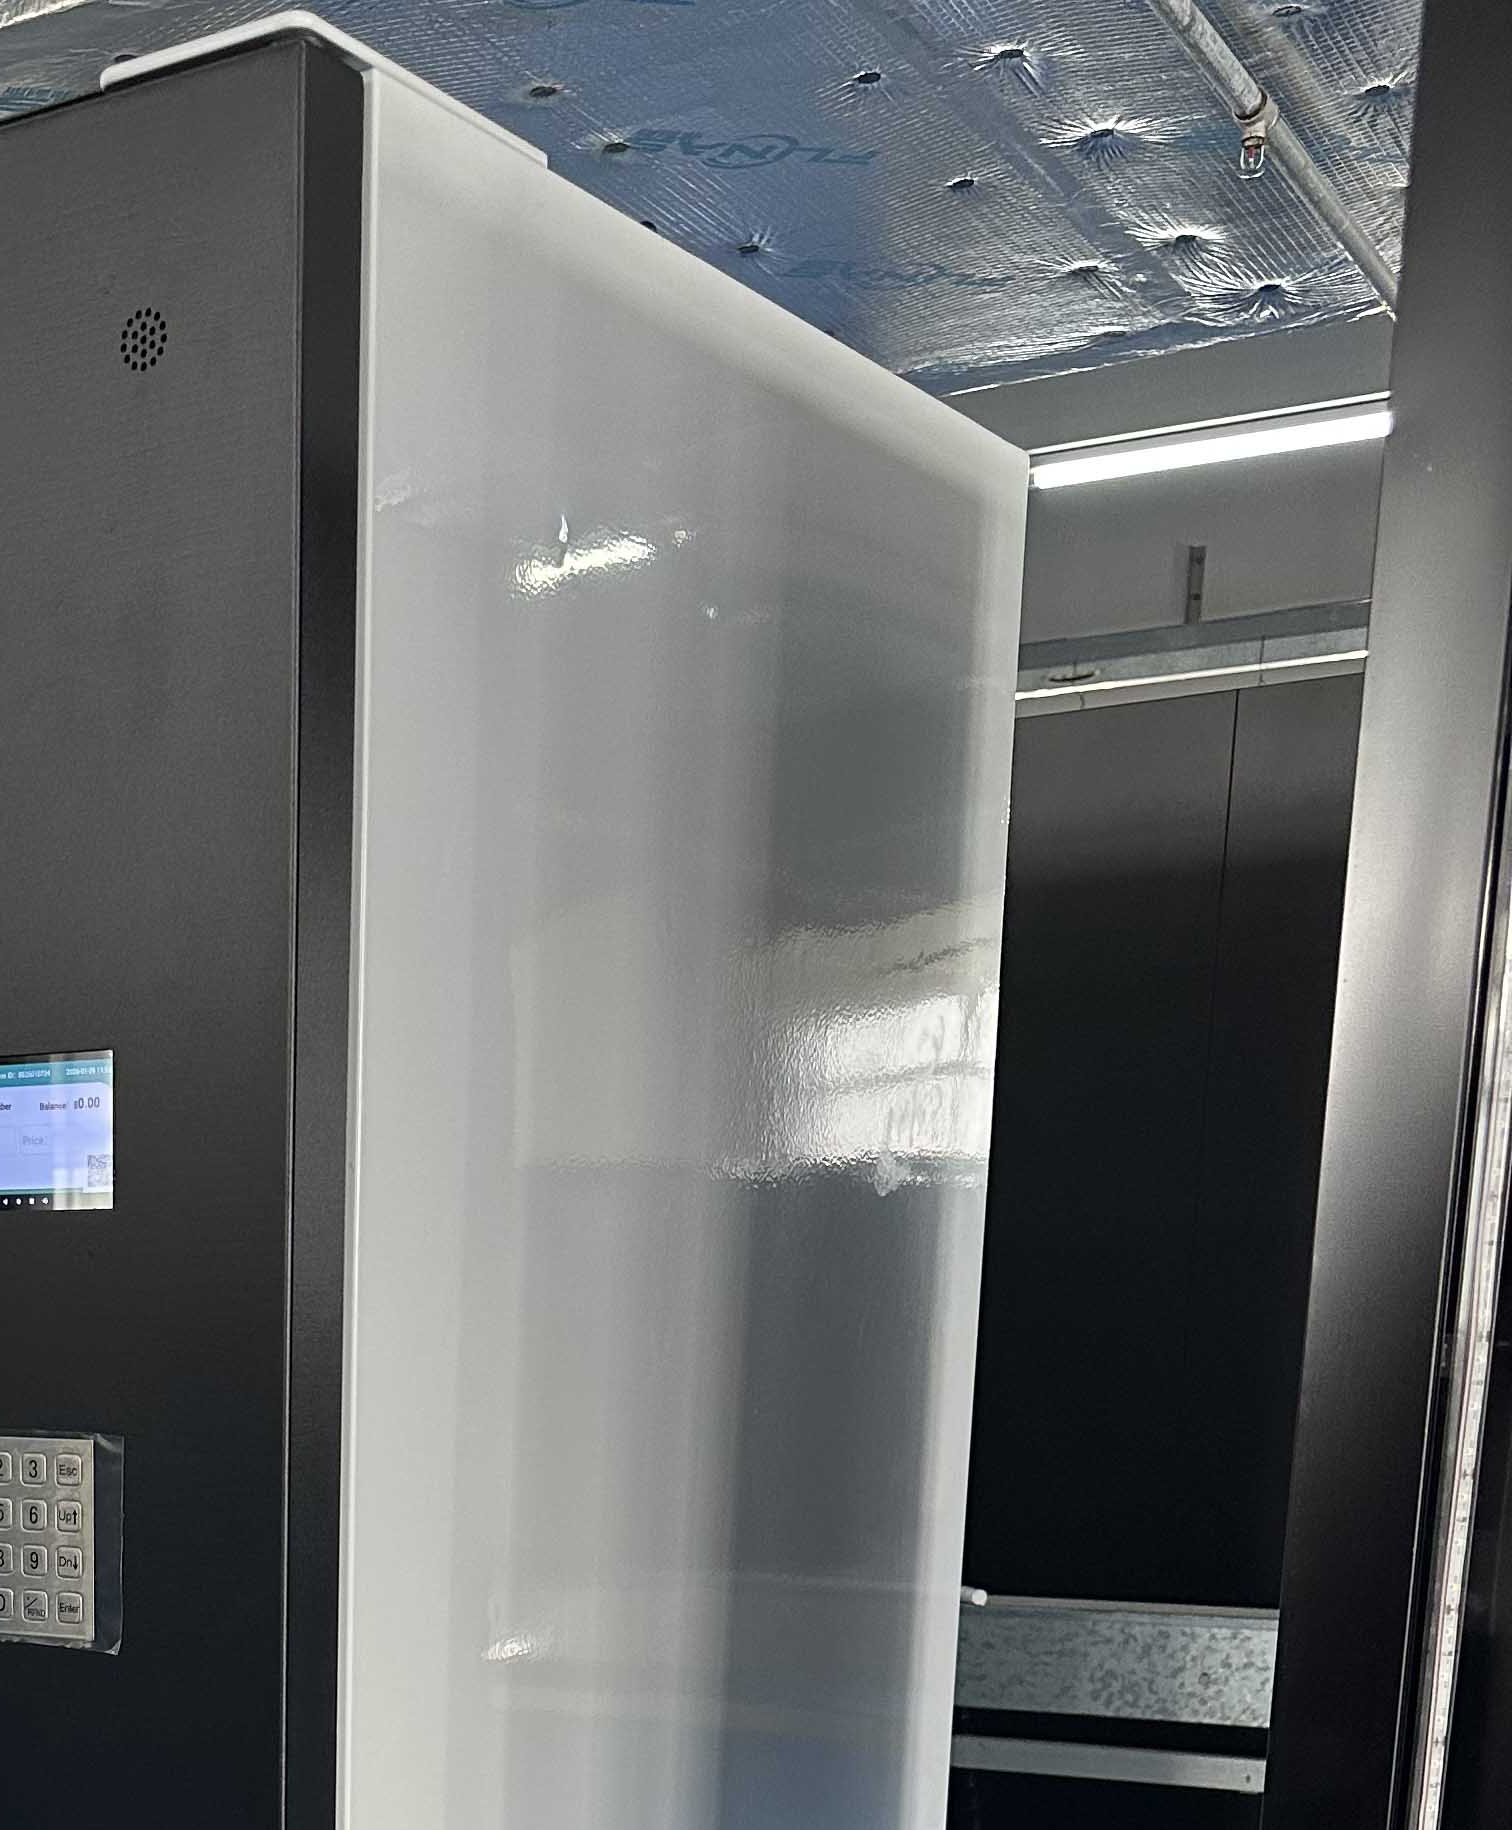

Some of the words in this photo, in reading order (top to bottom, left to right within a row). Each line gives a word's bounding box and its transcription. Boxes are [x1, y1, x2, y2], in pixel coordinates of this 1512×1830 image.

[28, 1459, 38, 1479] 3
[58, 1464, 78, 1477] Esc
[29, 1505, 38, 1525] 6
[29, 1550, 39, 1570] 9
[58, 1602, 80, 1614] Enter
